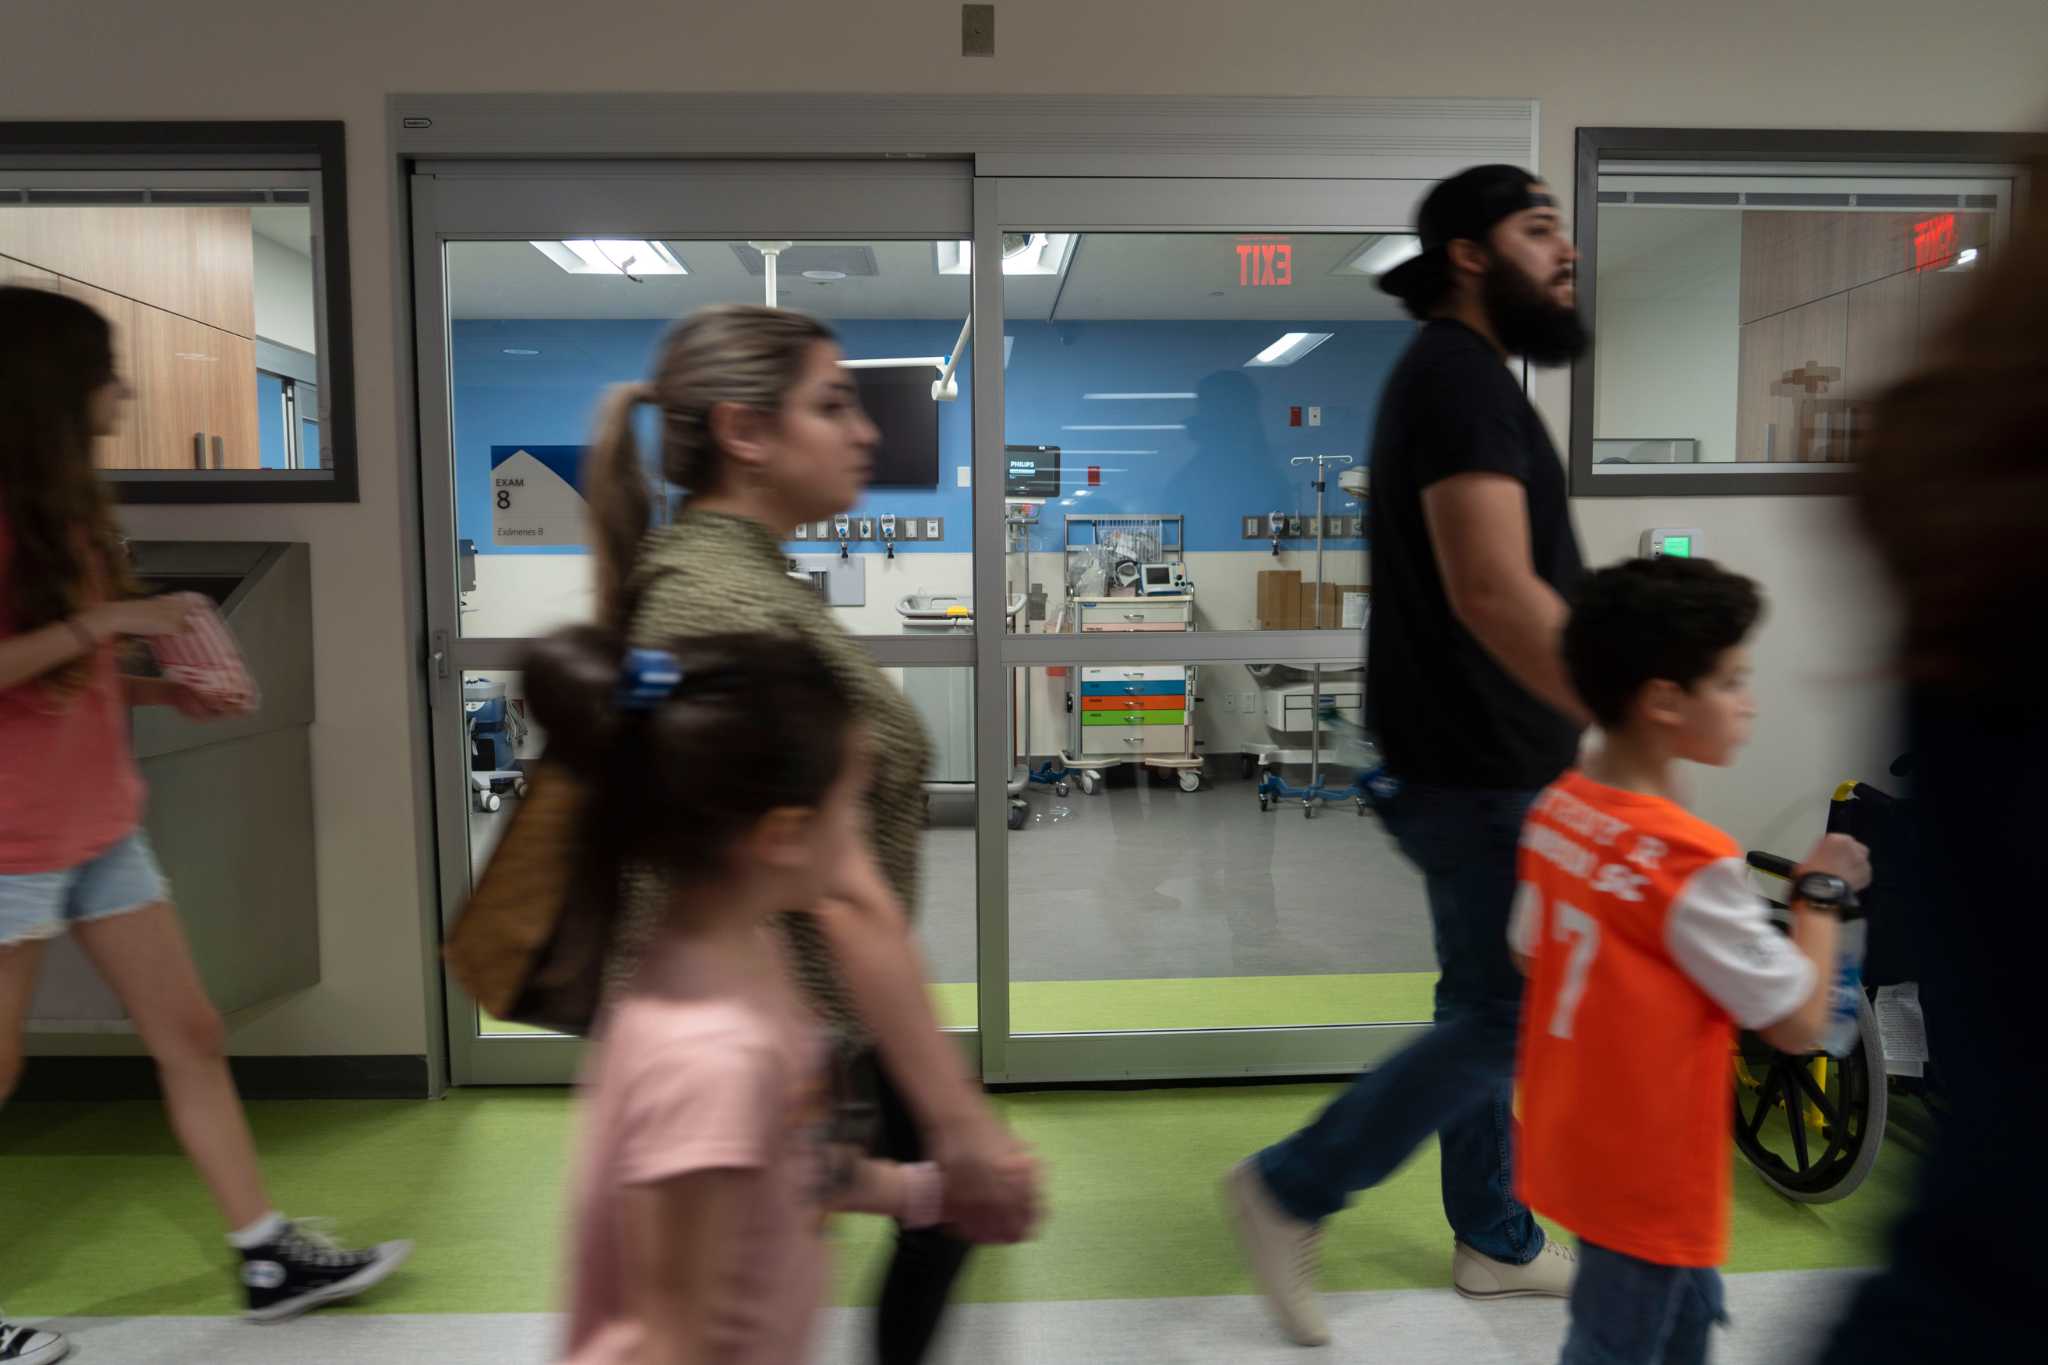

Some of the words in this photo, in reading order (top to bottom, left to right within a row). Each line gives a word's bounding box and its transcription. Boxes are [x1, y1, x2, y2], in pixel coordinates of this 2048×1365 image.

[1010, 460, 1035, 468] PHILIPS
[495, 478, 525, 487] EXAM
[497, 490, 511, 510] 8
[1549, 900, 1600, 1040] 7
